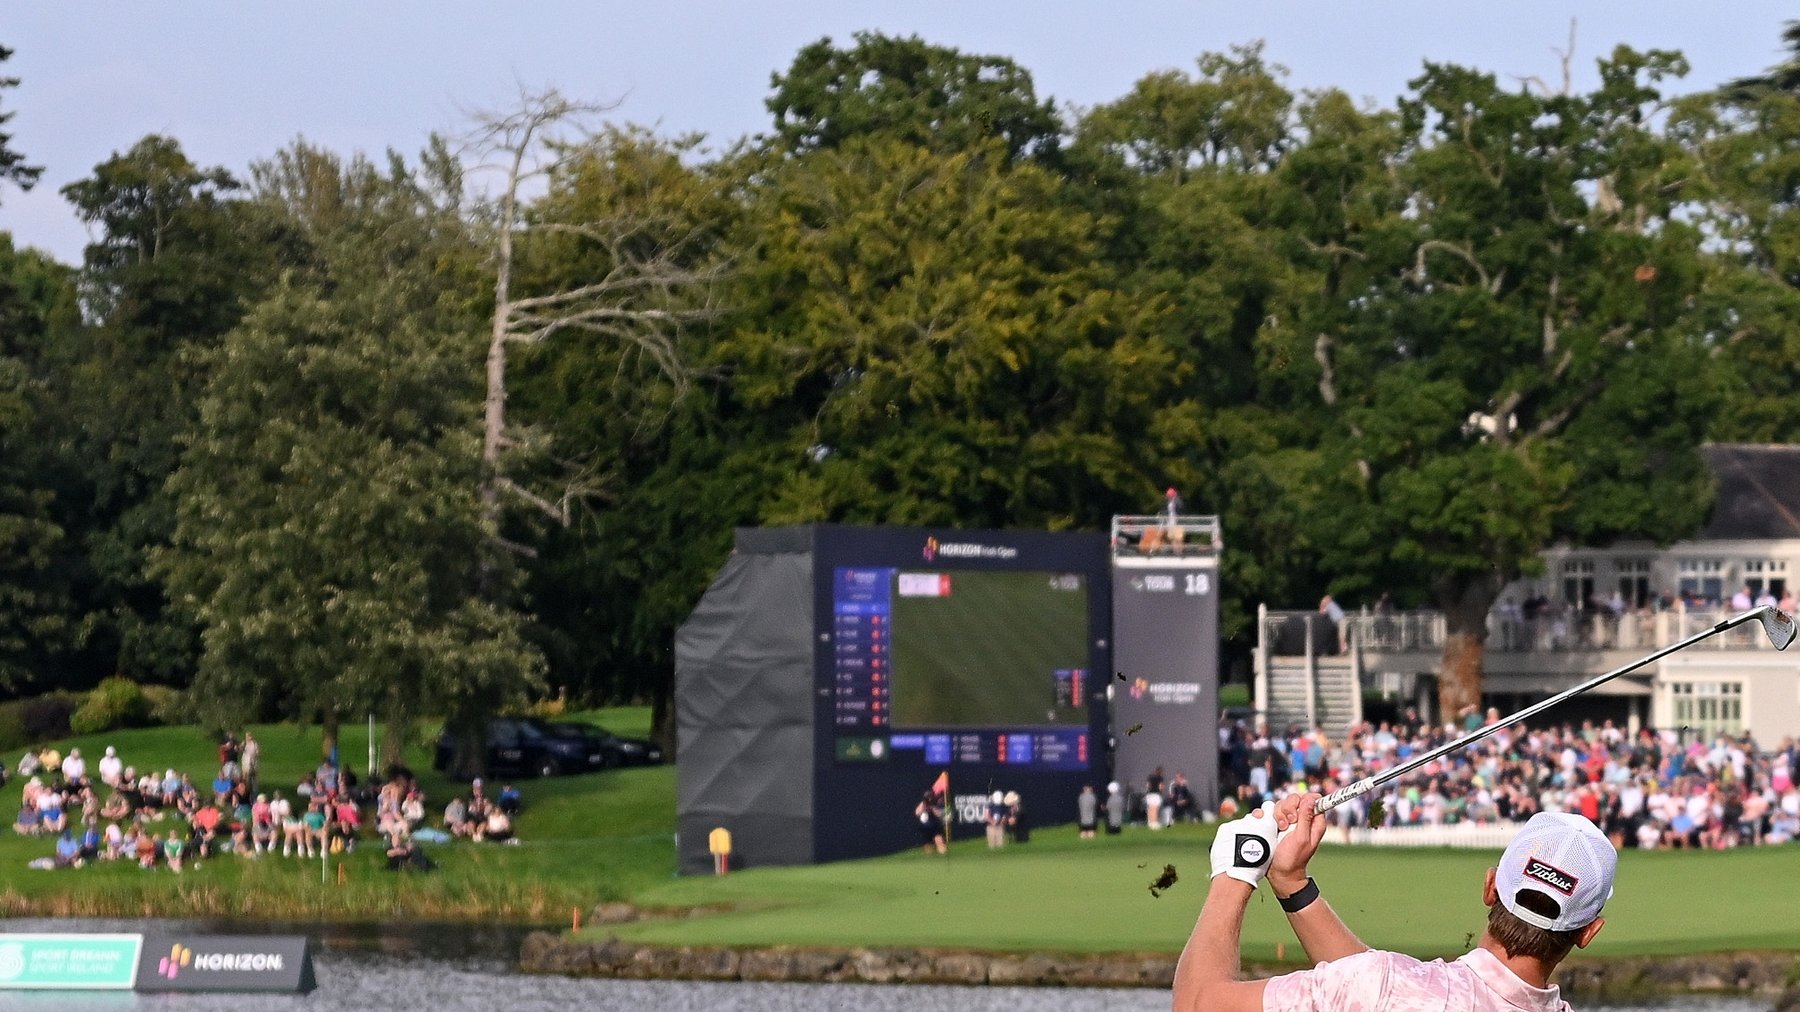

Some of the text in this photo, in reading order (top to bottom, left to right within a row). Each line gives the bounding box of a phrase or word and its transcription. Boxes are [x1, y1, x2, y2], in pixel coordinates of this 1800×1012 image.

[939, 543, 981, 557] HORIZON
[1185, 574, 1210, 595] 18
[1150, 683, 1200, 694] HORIZON
[1526, 862, 1573, 891] Titleist
[194, 953, 282, 971] HORIZON
